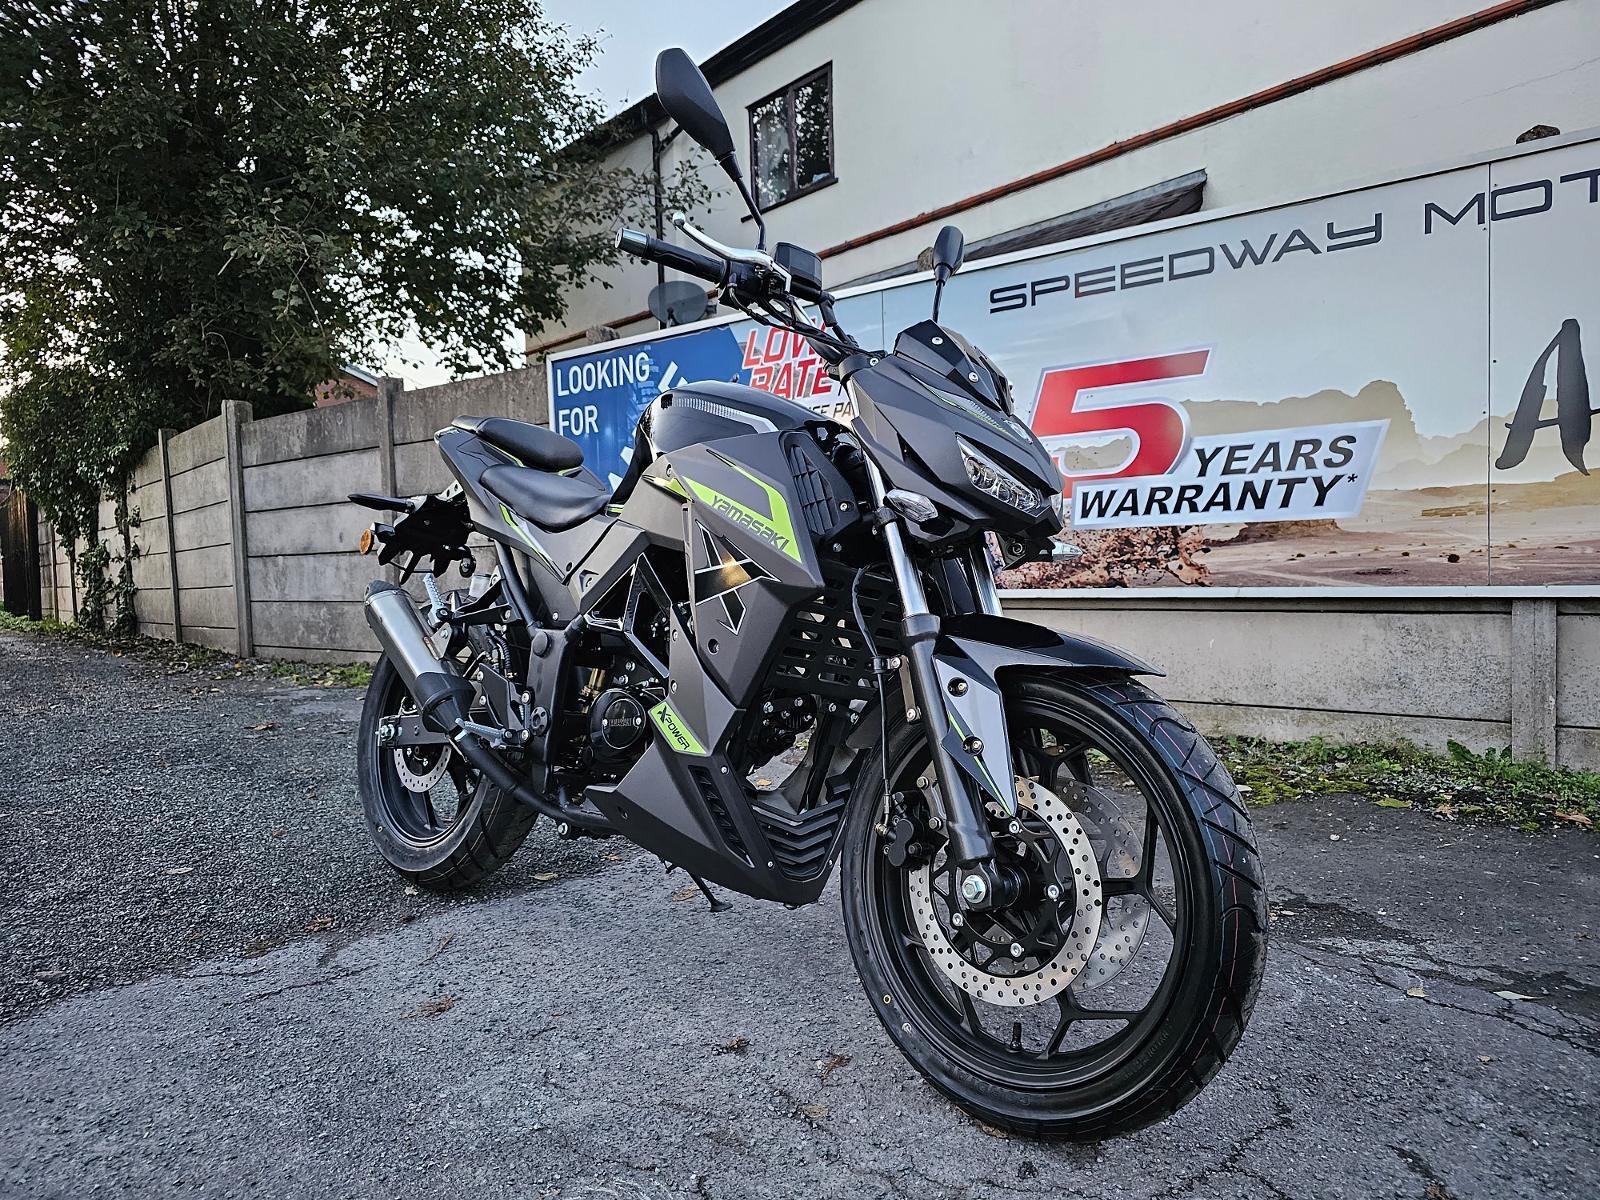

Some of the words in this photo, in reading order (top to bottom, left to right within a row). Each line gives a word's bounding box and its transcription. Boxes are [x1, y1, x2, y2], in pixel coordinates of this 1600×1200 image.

[989, 212, 1383, 315] SPEEDWAY
[556, 352, 650, 397] LOOKING
[558, 405, 599, 437] FOR
[1030, 349, 1211, 500] 5
[1194, 435, 1357, 478] YEARS
